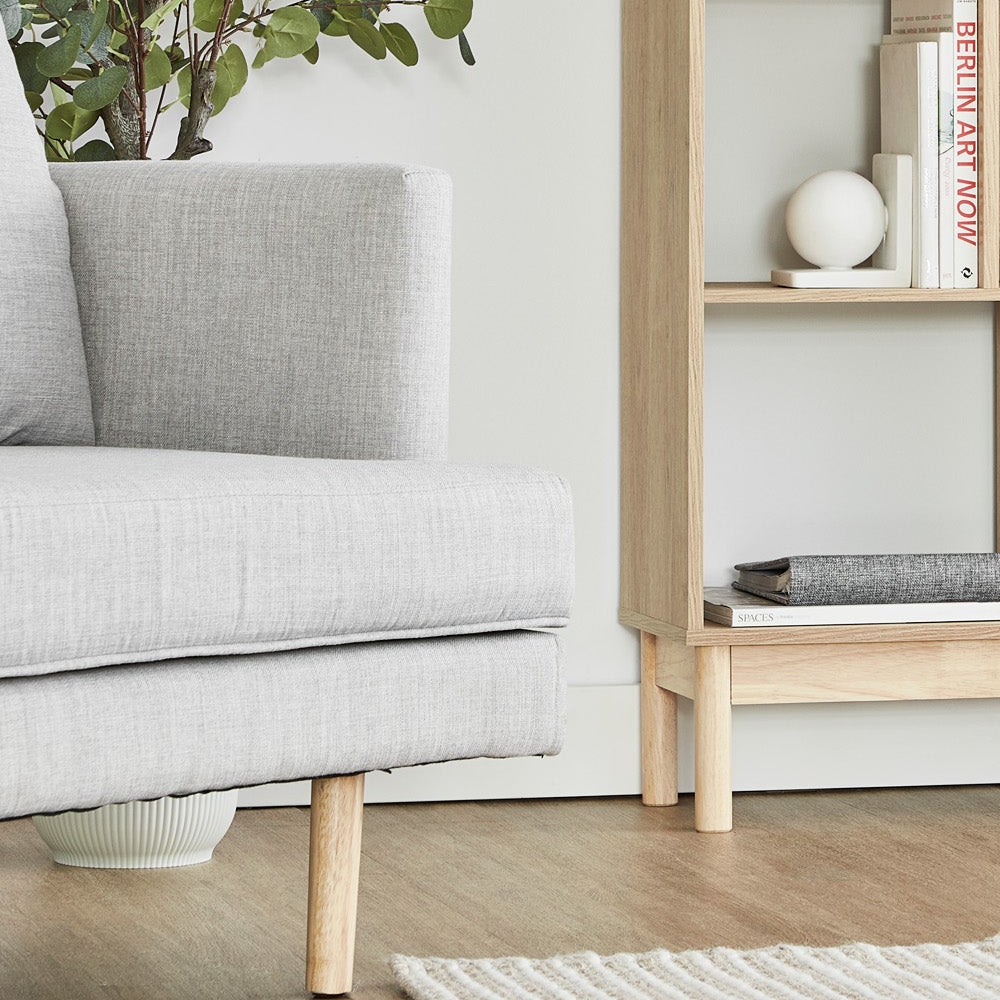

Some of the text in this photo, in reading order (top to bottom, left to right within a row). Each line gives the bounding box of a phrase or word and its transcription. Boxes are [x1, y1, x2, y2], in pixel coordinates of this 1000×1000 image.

[956, 21, 976, 112] BERLIN
[956, 119, 976, 171] ART
[956, 178, 977, 246] NOW
[737, 613, 774, 623] SPACES
